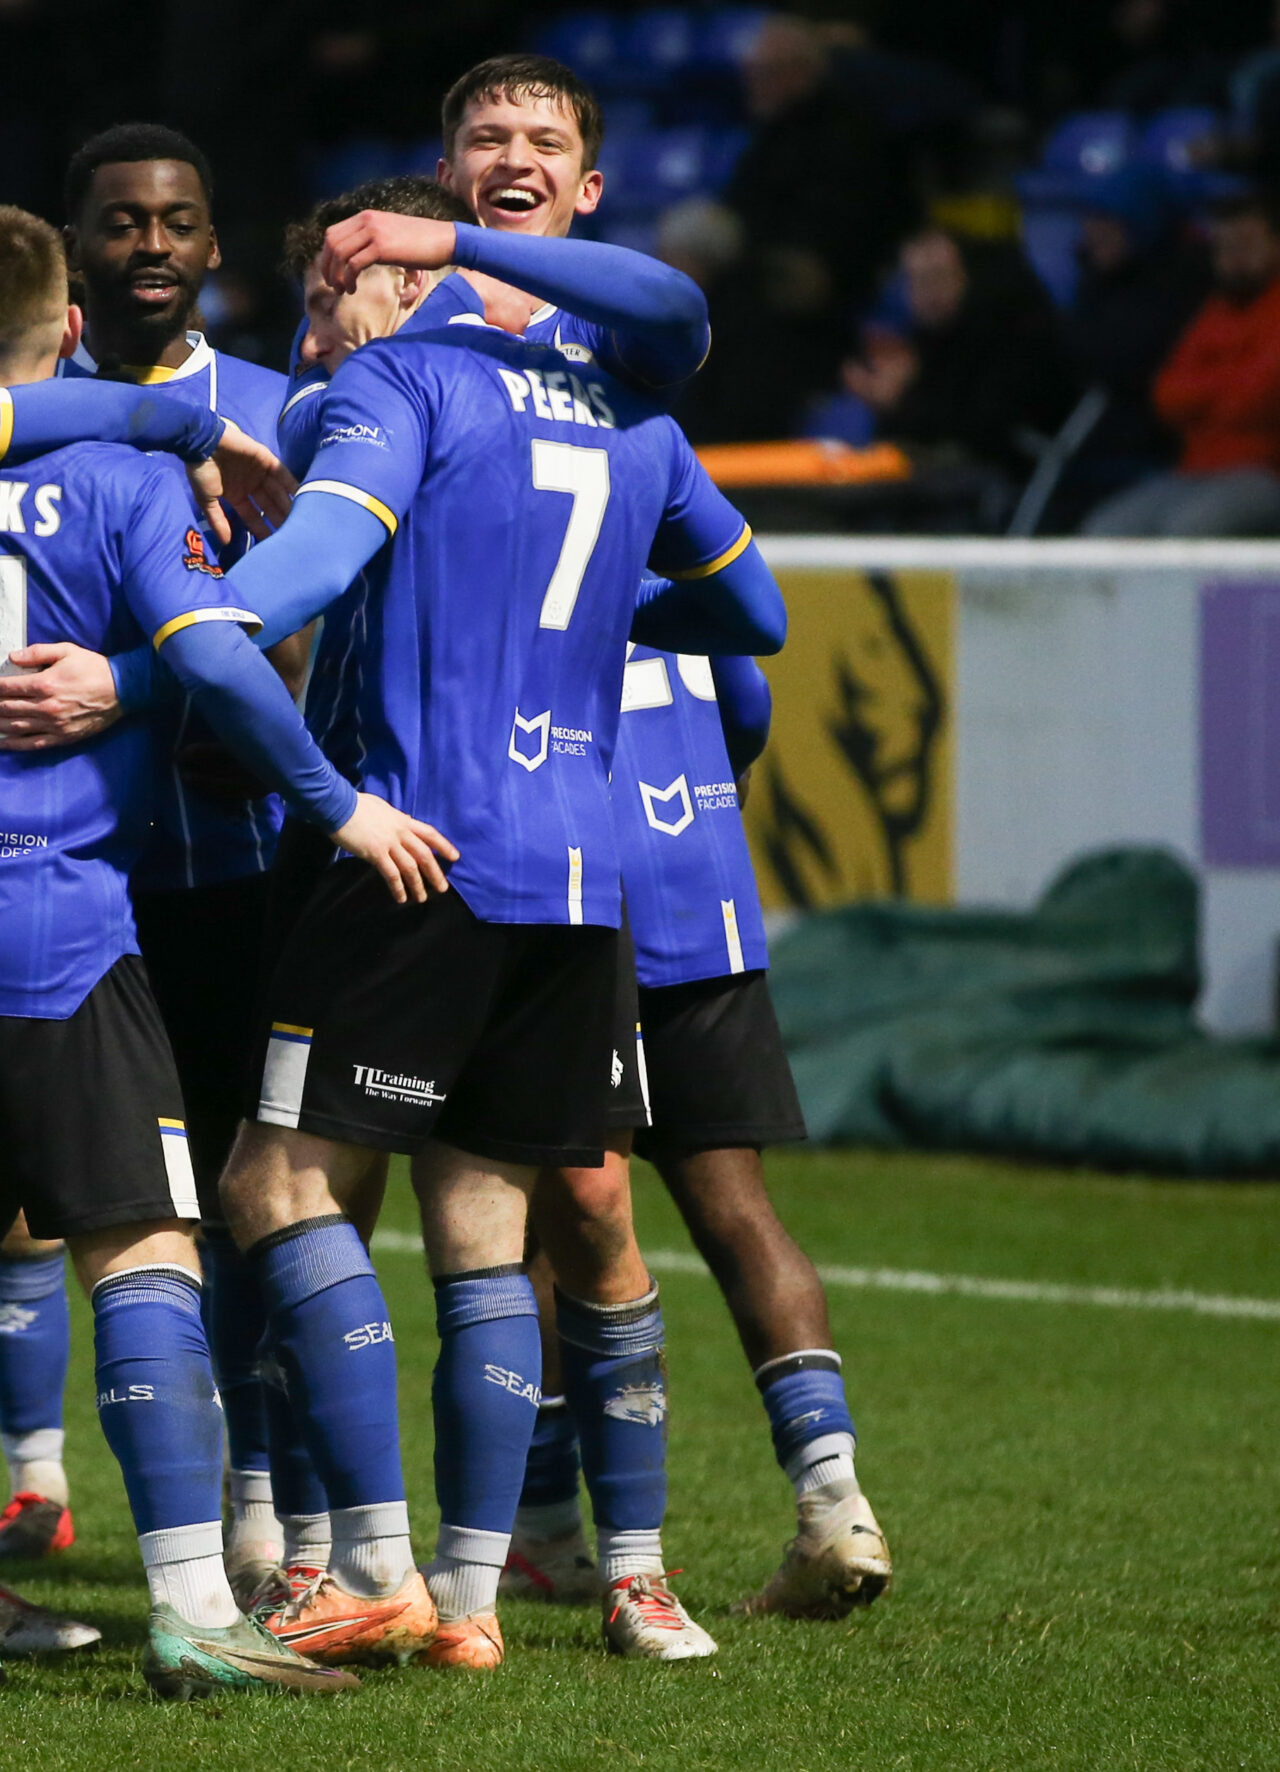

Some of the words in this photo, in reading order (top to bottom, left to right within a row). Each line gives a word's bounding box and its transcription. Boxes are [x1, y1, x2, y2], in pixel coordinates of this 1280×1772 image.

[531, 438, 611, 631] 7
[697, 795, 736, 811] FACADES
[365, 1087, 380, 1097] The
[381, 1090, 398, 1102] Way
[96, 1385, 155, 1408] ALS
[483, 1363, 542, 1408] SEAL
